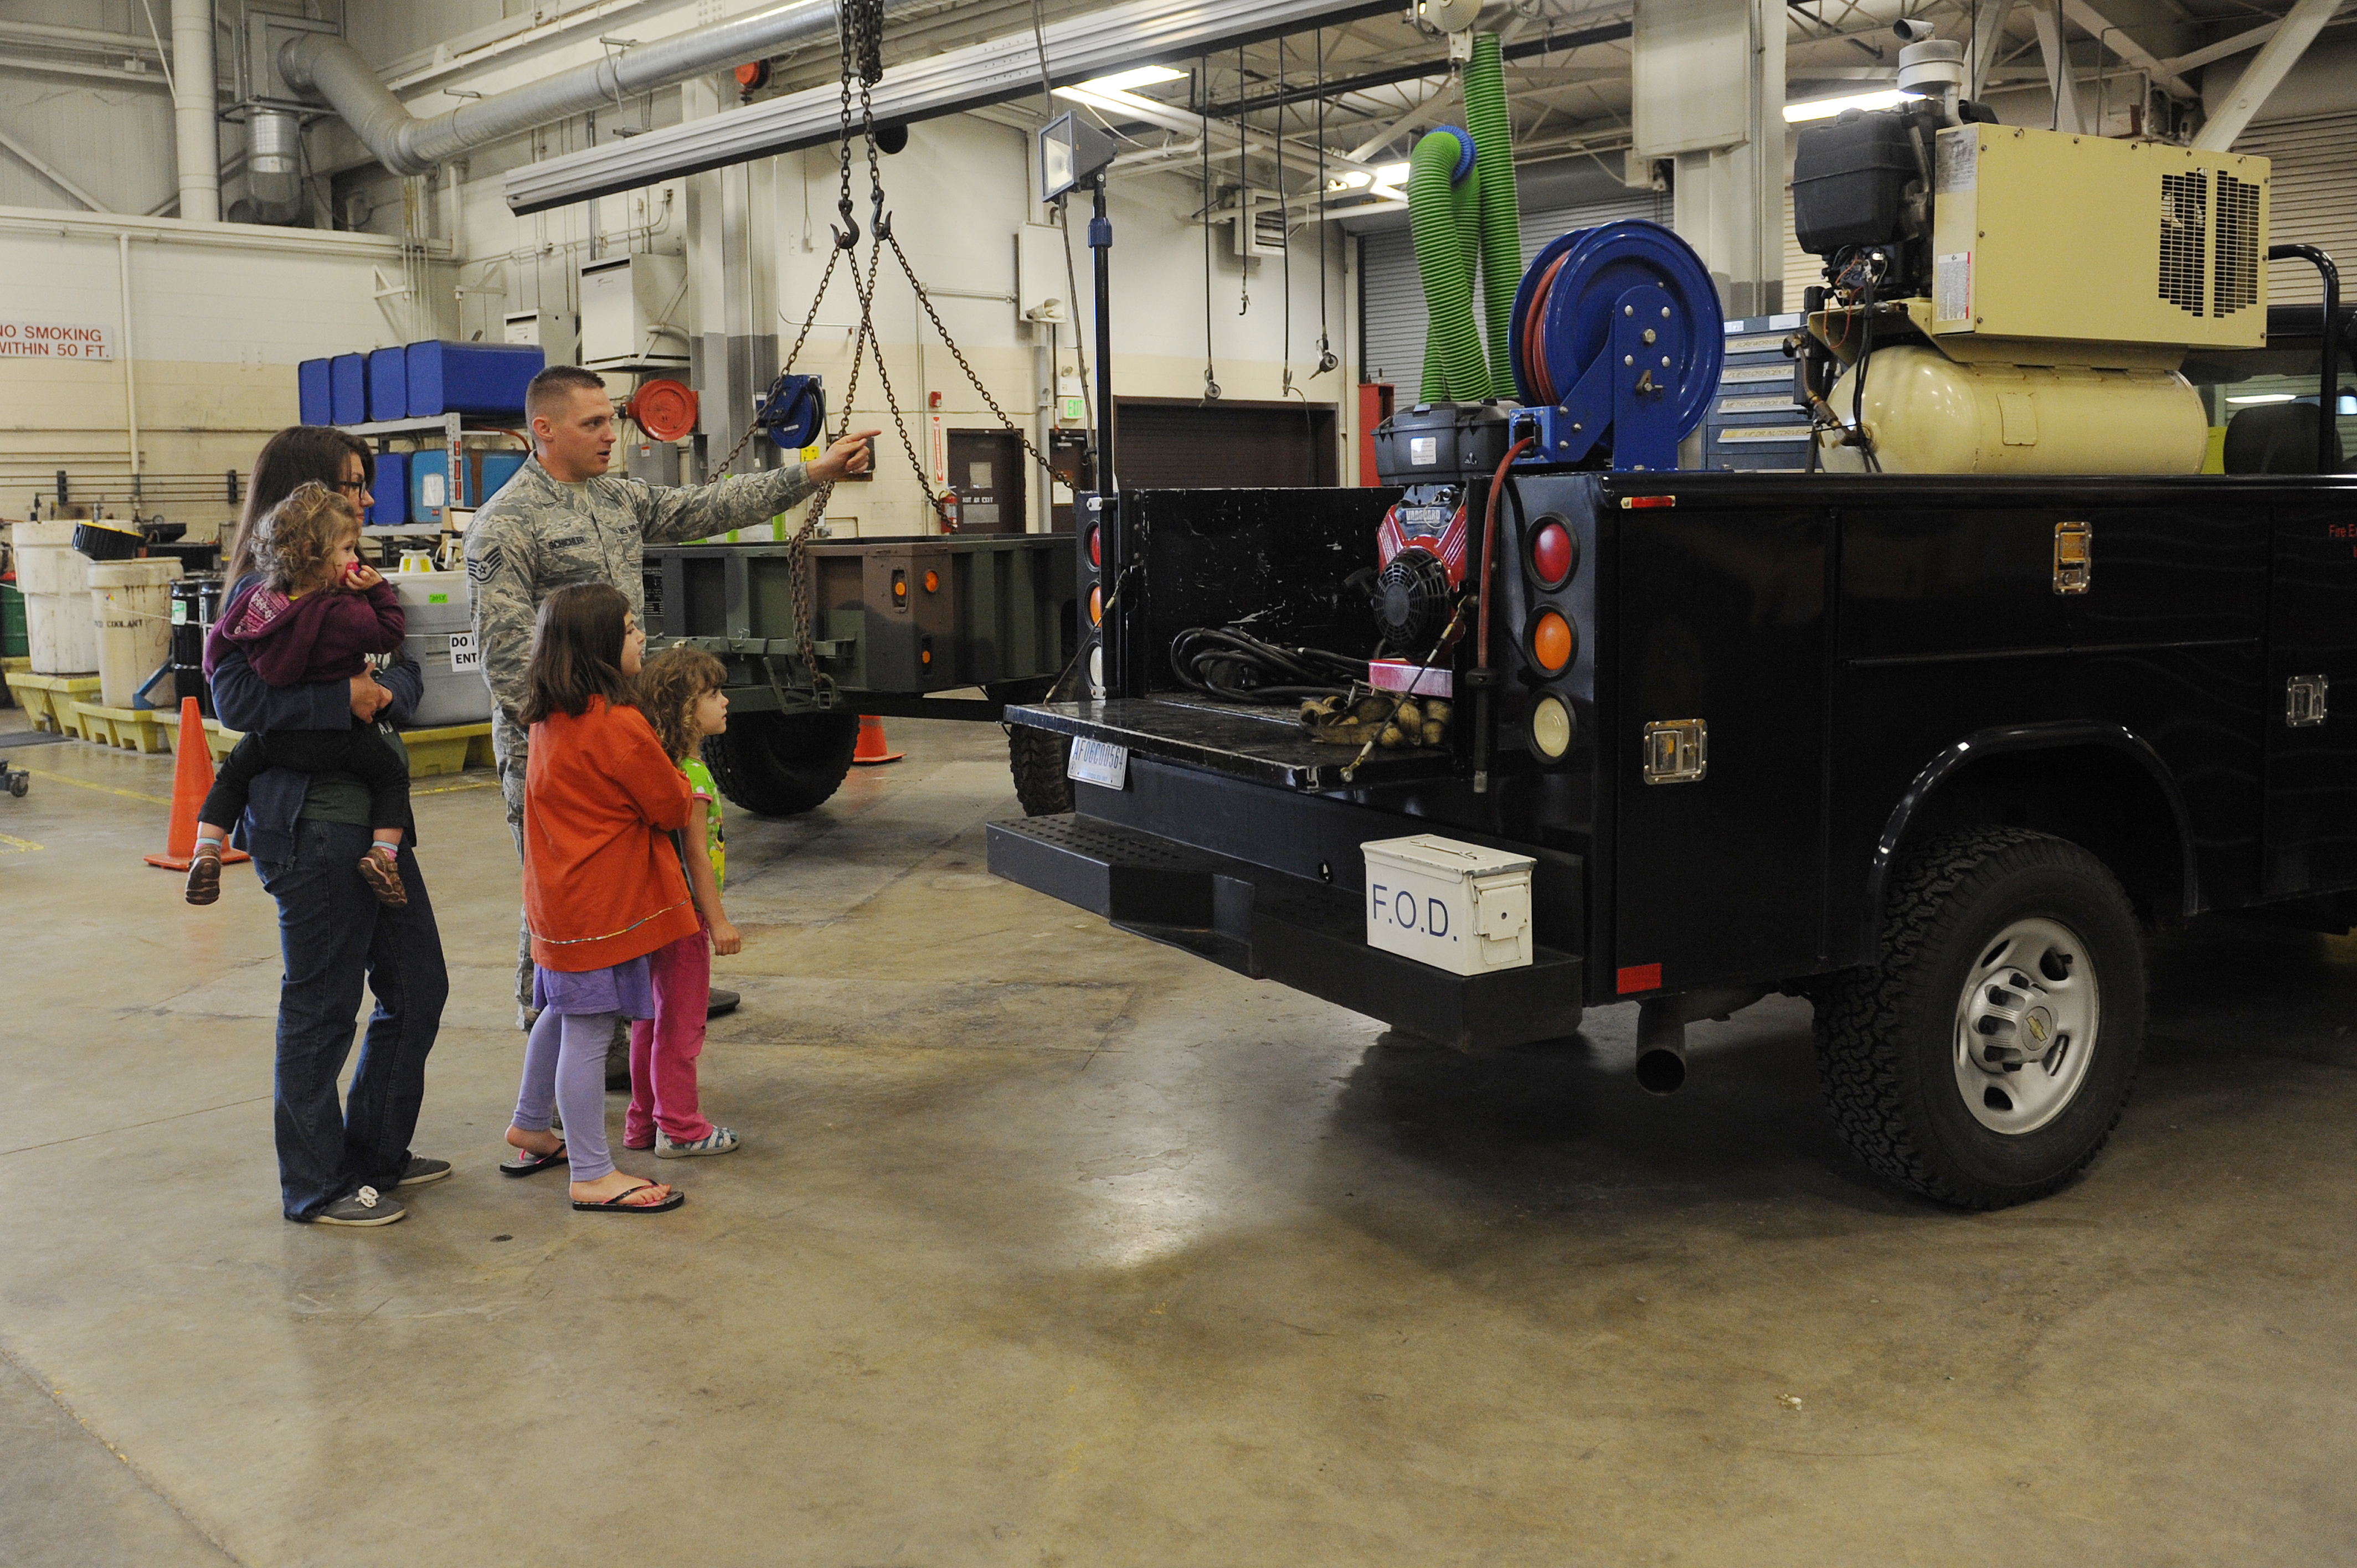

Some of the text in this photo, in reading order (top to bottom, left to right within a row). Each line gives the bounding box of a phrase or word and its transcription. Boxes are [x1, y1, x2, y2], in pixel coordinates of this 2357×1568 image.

[0, 324, 101, 342] O SMOKING
[57, 344, 78, 356] 50
[86, 345, 109, 357] FT.
[1068, 400, 1083, 416] EXIT
[2329, 524, 2346, 537] Fire
[451, 636, 468, 647] DO
[1072, 739, 1124, 770] AF06C00564
[1373, 884, 1457, 941] F.O.D.
